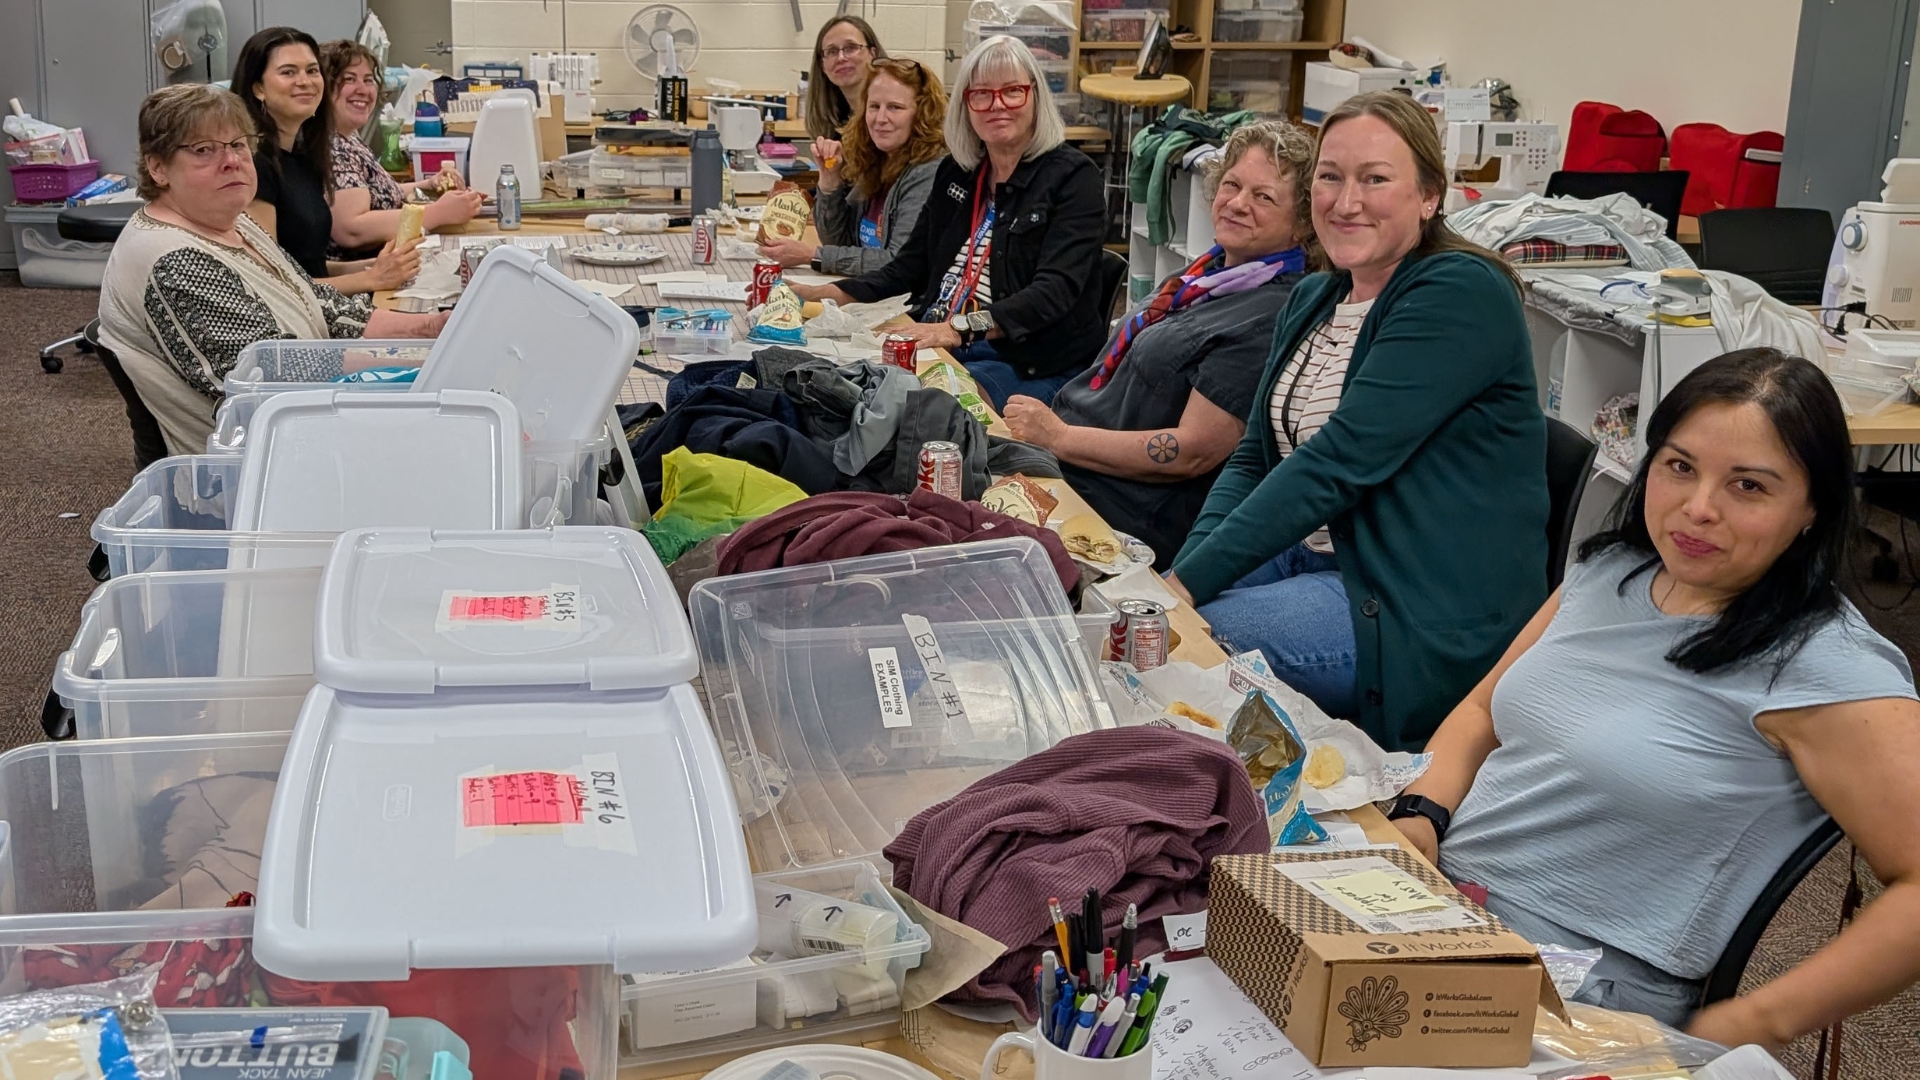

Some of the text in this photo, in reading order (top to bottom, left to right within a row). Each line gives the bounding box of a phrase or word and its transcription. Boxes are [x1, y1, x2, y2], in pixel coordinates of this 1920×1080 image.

[694, 227, 707, 254] Bro
[914, 632, 952, 684] BIN
[940, 691, 964, 719] #1
[874, 662, 893, 714] EXAMPLES
[886, 659, 904, 716] SIM Clothing
[591, 771, 626, 824] BIN #6
[1333, 886, 1390, 914] Zippers
[1373, 892, 1397, 903] for
[1392, 880, 1434, 900] Mary
[1402, 943, 1416, 953] It
[1435, 993, 1493, 1001] ItWorksGlobal.com
[1433, 1010, 1520, 1018] facebook.com/ItWorksGlobal
[1430, 1026, 1511, 1035] twitter.com/ItWorksGlobal
[237, 1068, 332, 1079] JEAN TACK
